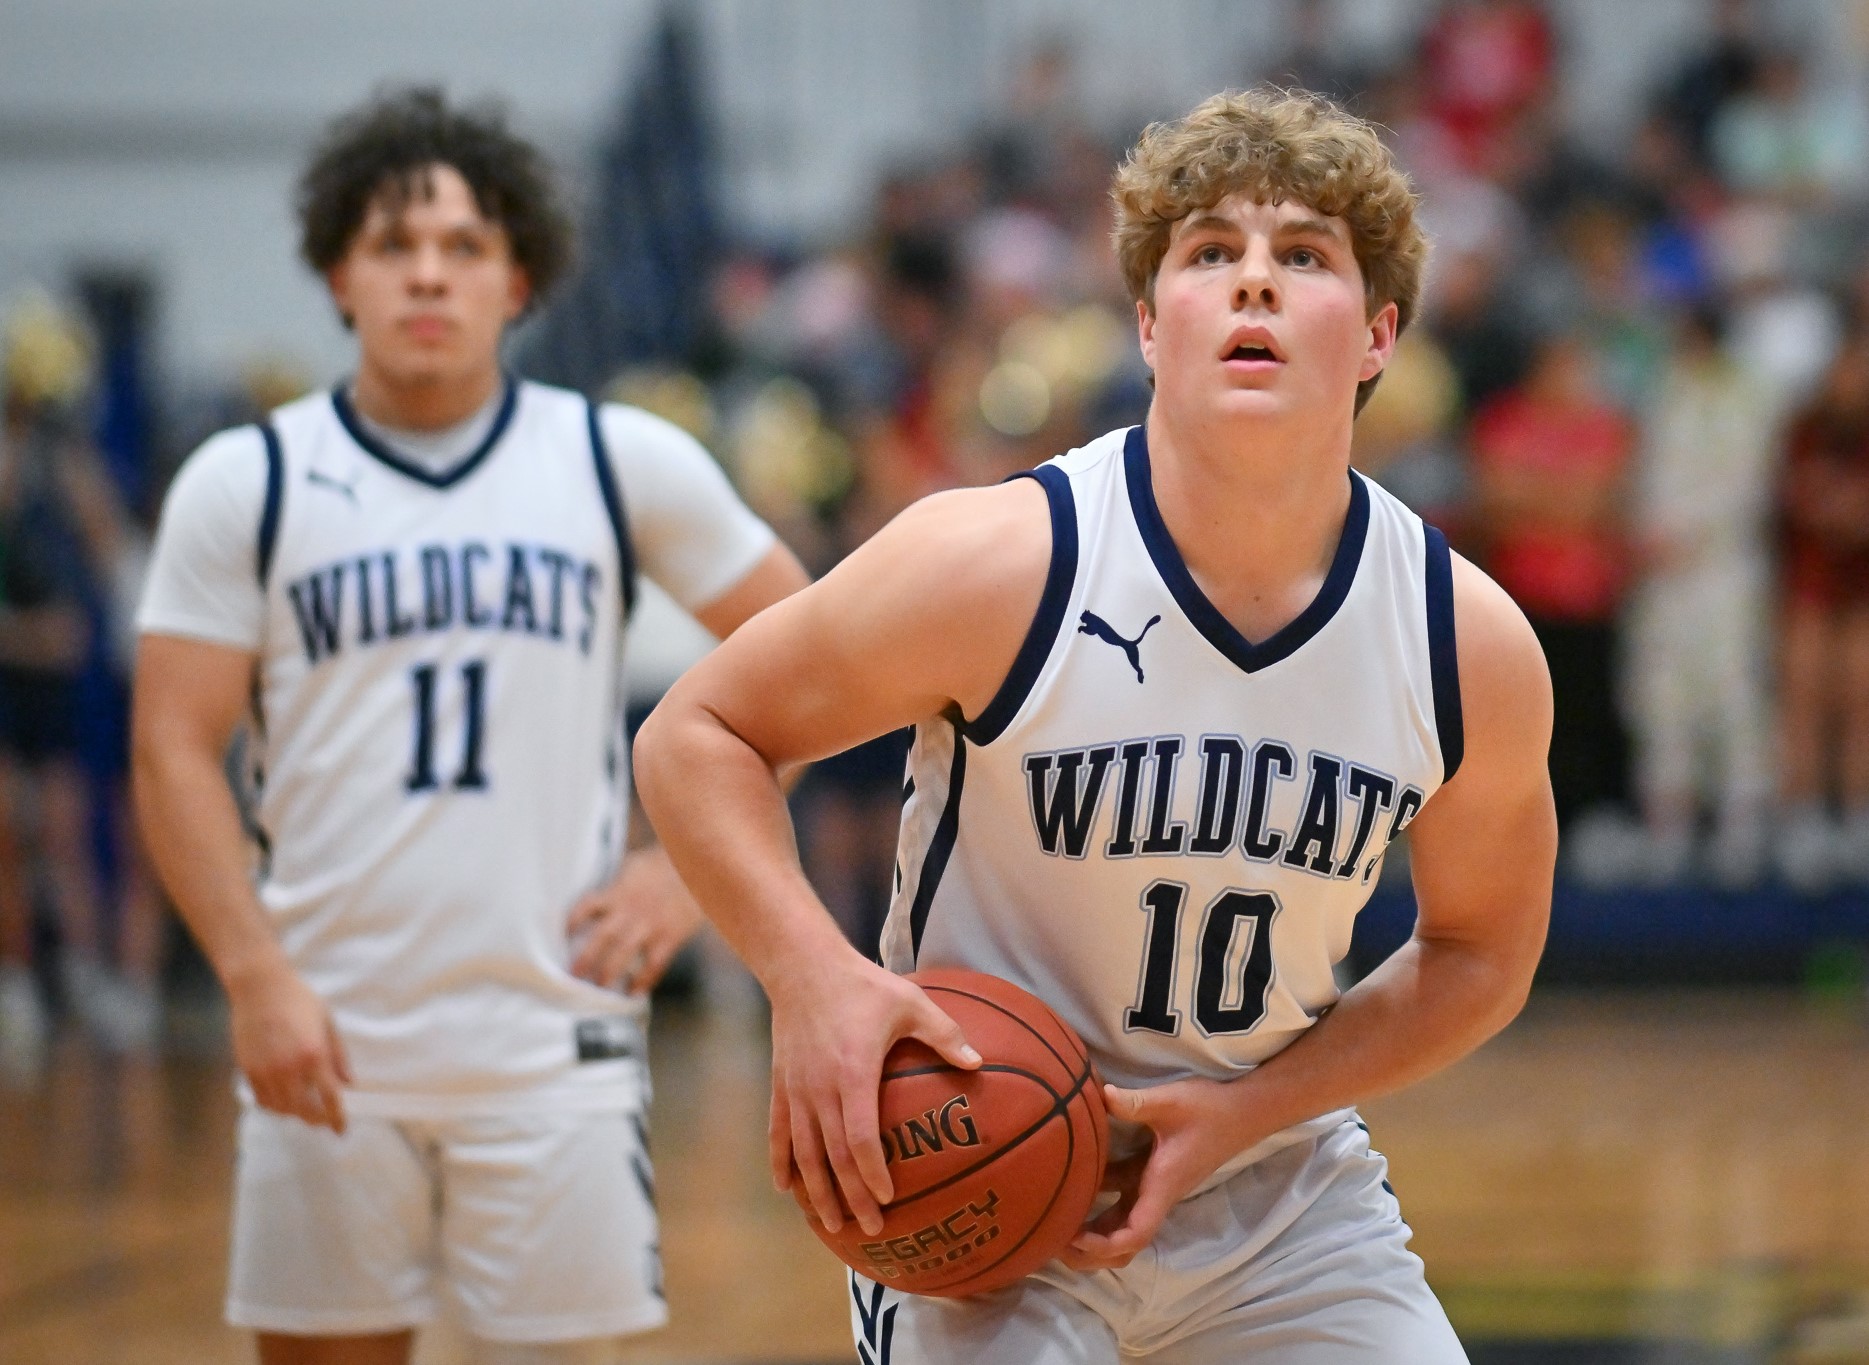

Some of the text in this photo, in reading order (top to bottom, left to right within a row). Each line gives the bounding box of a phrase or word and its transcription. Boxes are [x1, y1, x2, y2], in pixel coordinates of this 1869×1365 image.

[287, 543, 600, 665] WILDCATS
[406, 661, 488, 791] 11
[1023, 735, 1425, 883] WILDCATS
[1124, 879, 1283, 1038] 10
